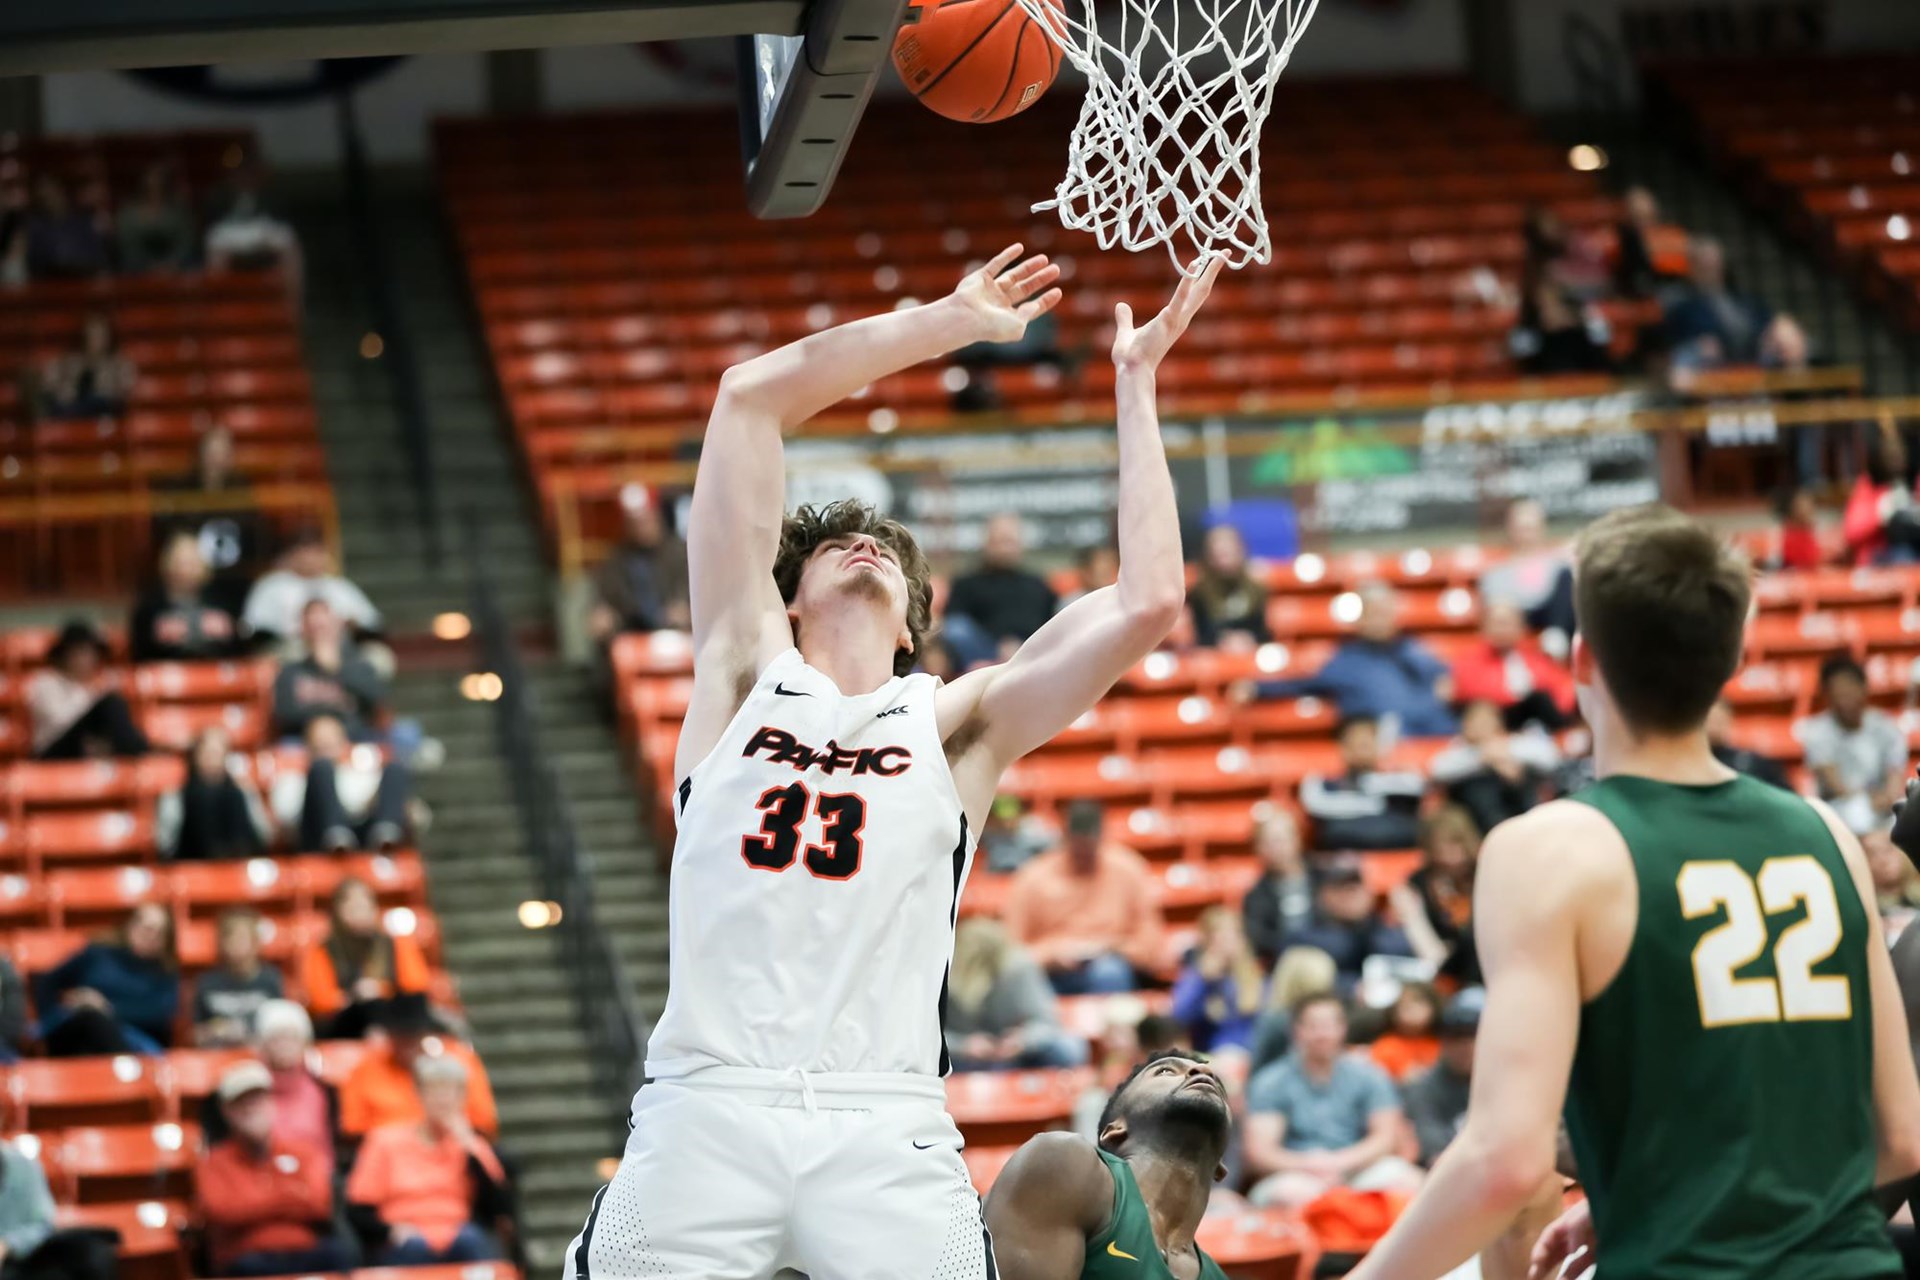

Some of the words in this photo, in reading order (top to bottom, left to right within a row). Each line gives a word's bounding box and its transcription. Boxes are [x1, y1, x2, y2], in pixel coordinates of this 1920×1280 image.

[876, 704, 909, 719] WCC
[742, 726, 912, 777] PAFIC
[741, 780, 867, 881] 33
[1676, 854, 1852, 1029] 22
